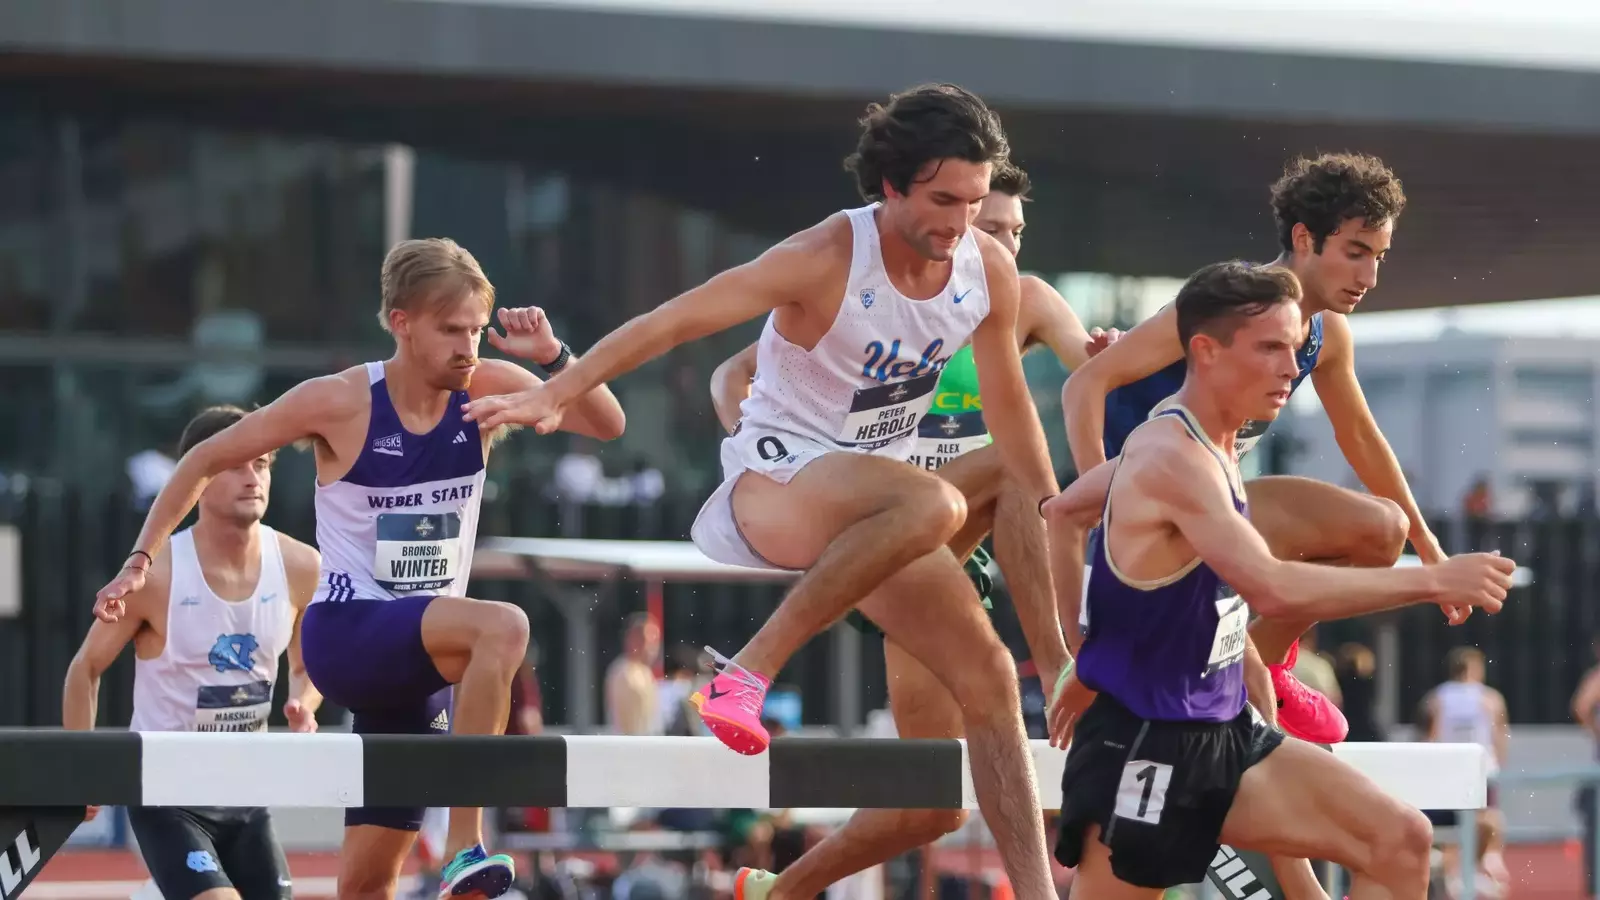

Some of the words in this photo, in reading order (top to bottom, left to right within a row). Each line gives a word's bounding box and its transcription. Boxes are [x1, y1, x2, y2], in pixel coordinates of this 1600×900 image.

[878, 406, 906, 420] PETER
[855, 413, 917, 440] HEROLD
[936, 443, 960, 454] ALEX
[367, 493, 424, 509] WEBER
[431, 484, 474, 503] STATE
[401, 545, 443, 556] BRONSON
[390, 558, 448, 578] WINTER
[214, 709, 257, 722] MARSHALL
[1136, 764, 1158, 818] 1
